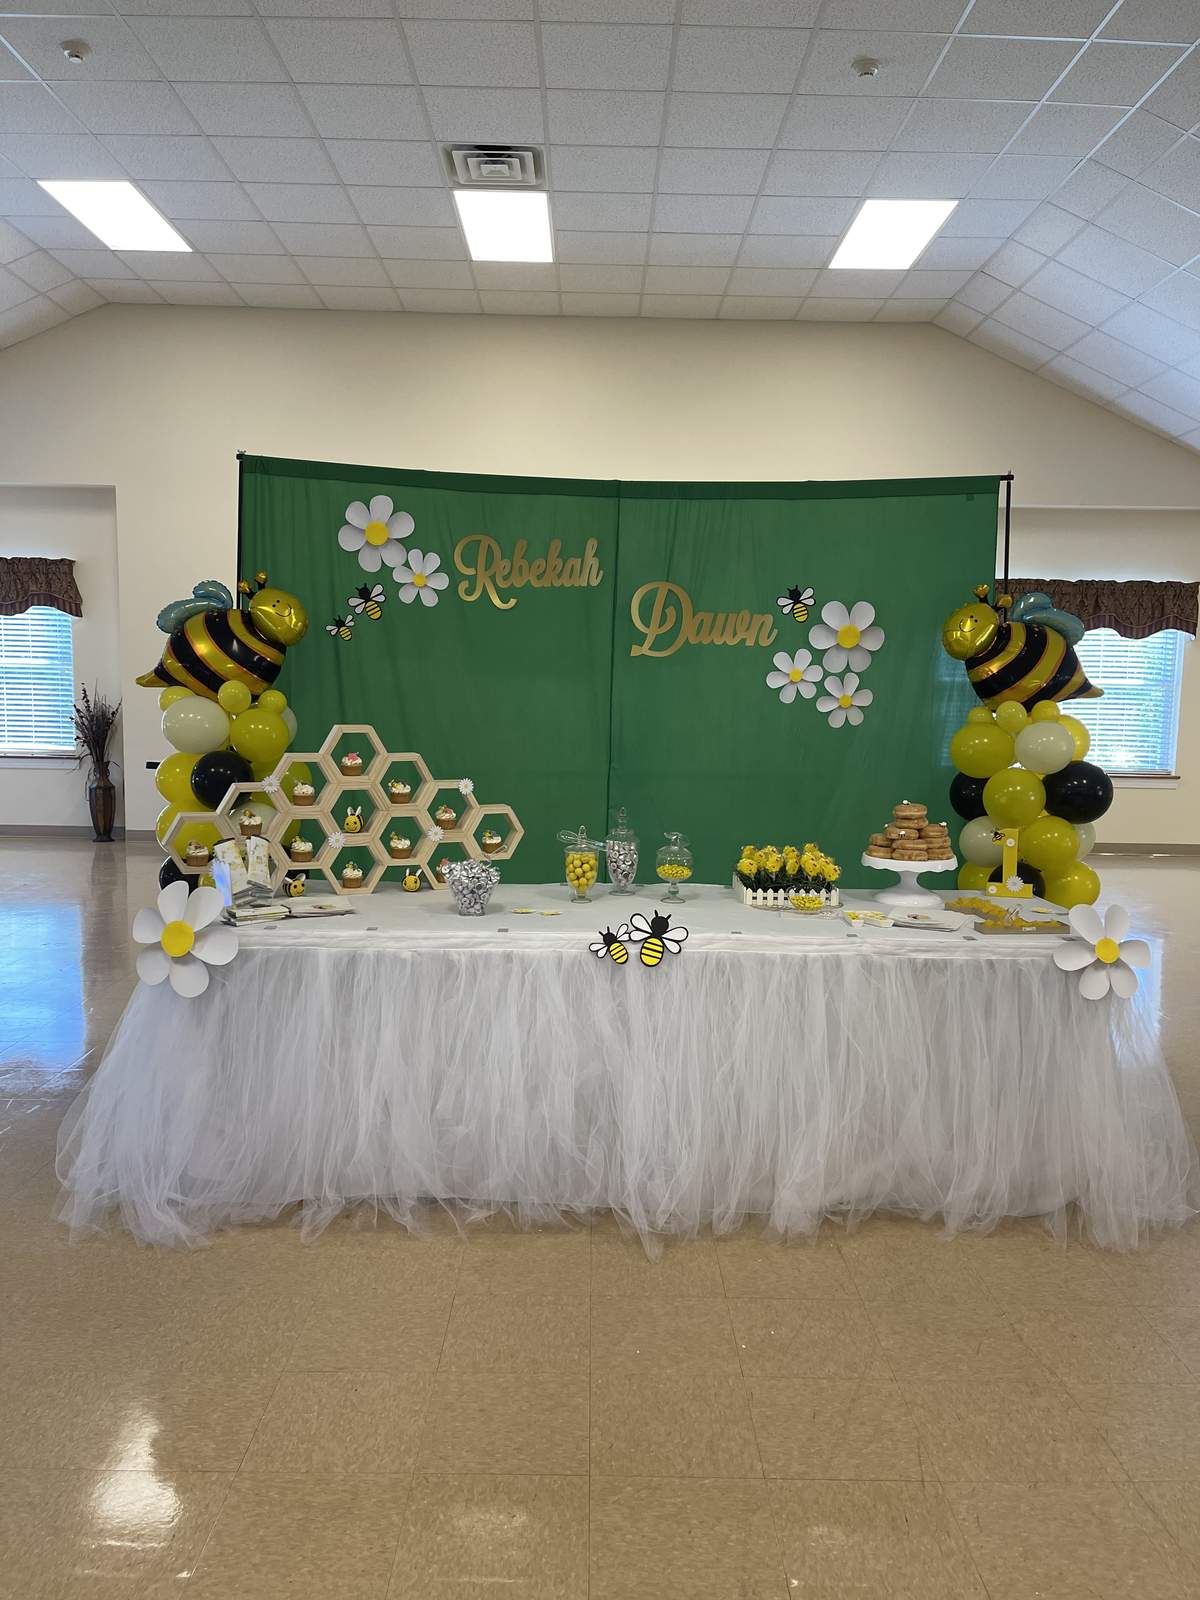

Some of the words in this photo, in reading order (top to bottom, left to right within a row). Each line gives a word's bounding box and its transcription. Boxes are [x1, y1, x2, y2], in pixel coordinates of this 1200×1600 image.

[454, 534, 603, 609] Rebekah
[631, 581, 778, 658] Dawn
[985, 827, 1034, 899] 1
